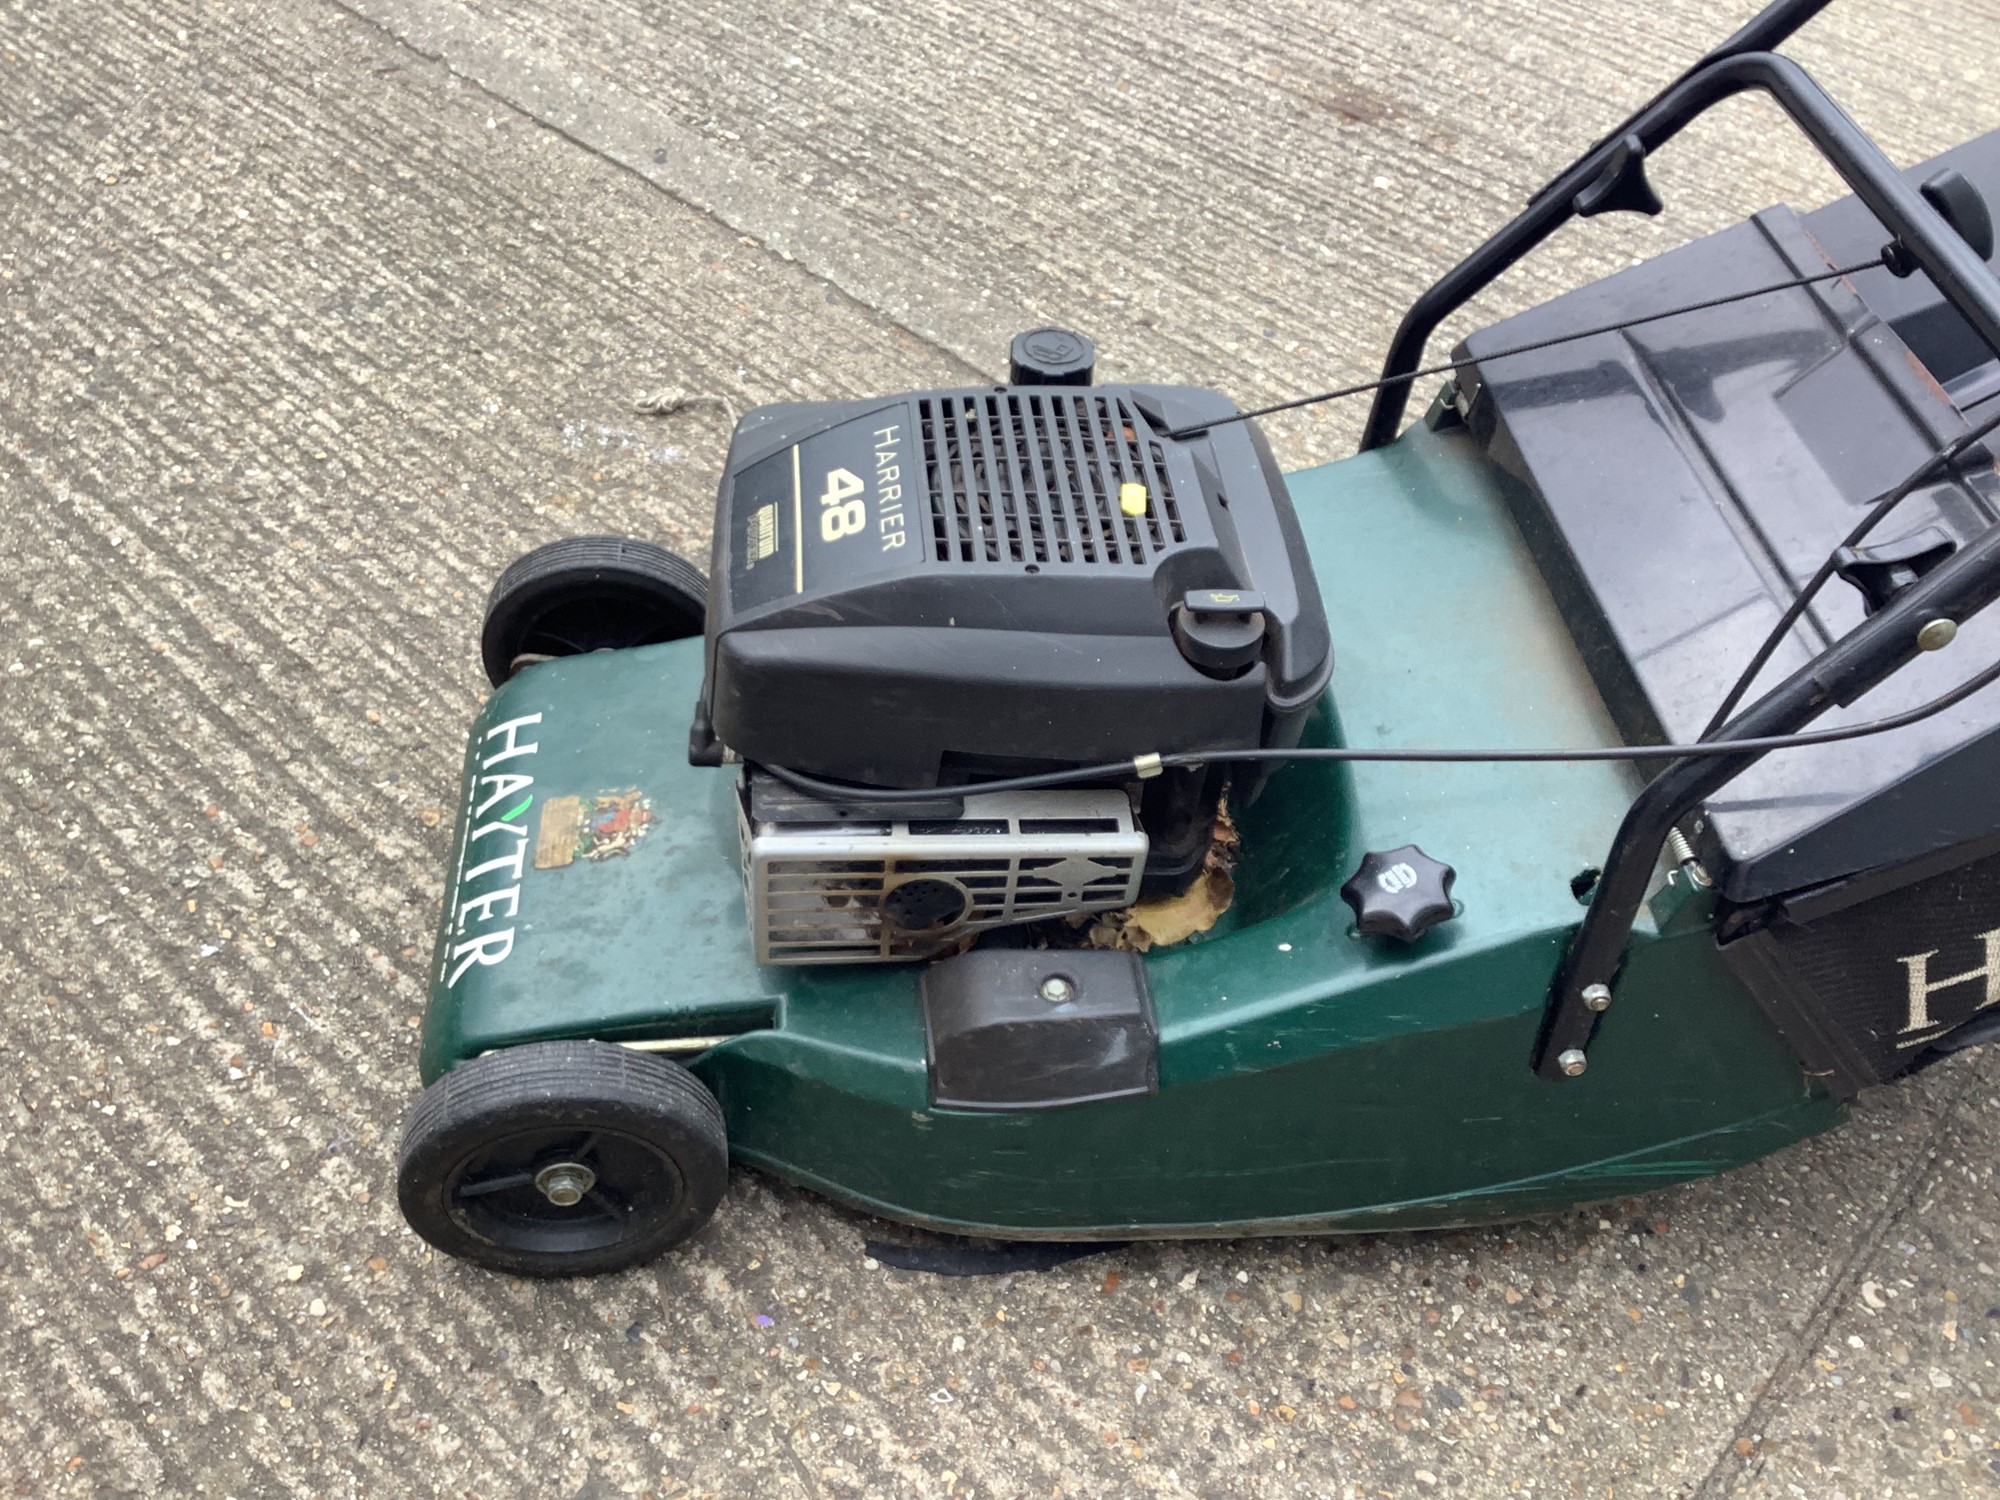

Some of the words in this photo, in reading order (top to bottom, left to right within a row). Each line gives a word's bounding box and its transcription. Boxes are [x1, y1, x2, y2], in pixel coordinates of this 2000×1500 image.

[821, 468, 866, 543] 48
[873, 425, 906, 552] HARRIER
[447, 711, 543, 989] HAYTER
